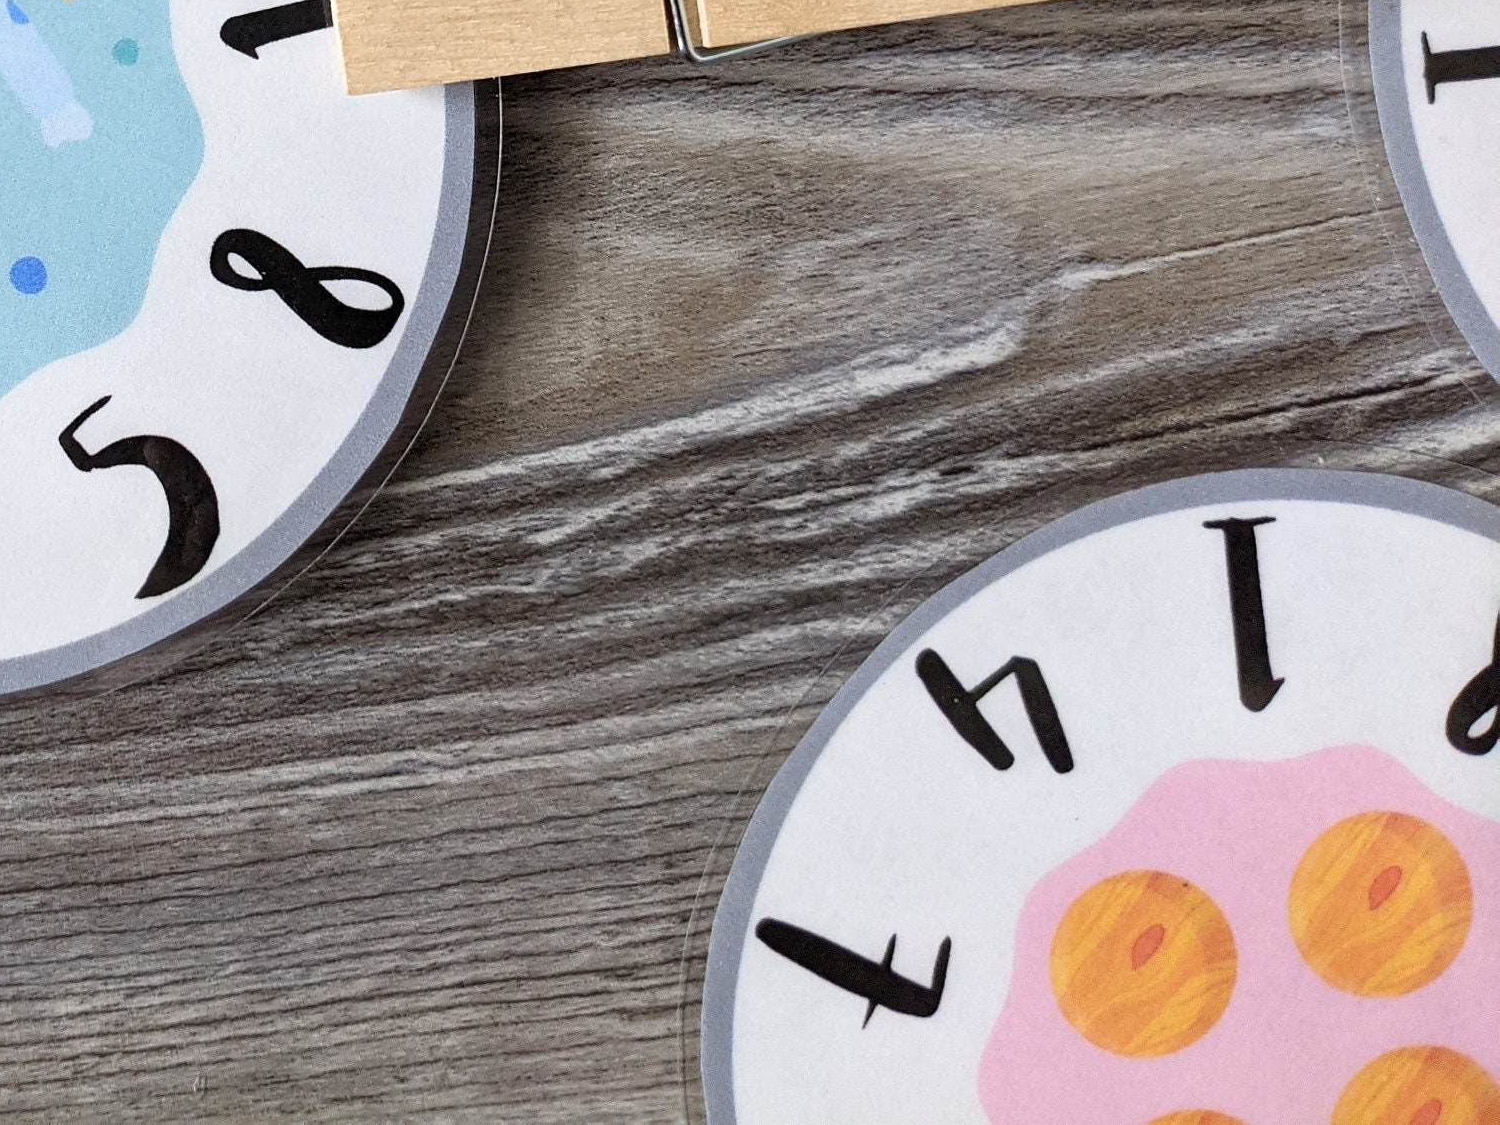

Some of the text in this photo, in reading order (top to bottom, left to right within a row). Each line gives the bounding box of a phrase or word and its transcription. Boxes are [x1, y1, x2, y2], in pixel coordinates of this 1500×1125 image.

[209, 228, 405, 350] 8
[58, 395, 221, 600] 5
[1203, 516, 1285, 713] 1
[915, 648, 1074, 774] 4
[755, 917, 952, 1030] 7
